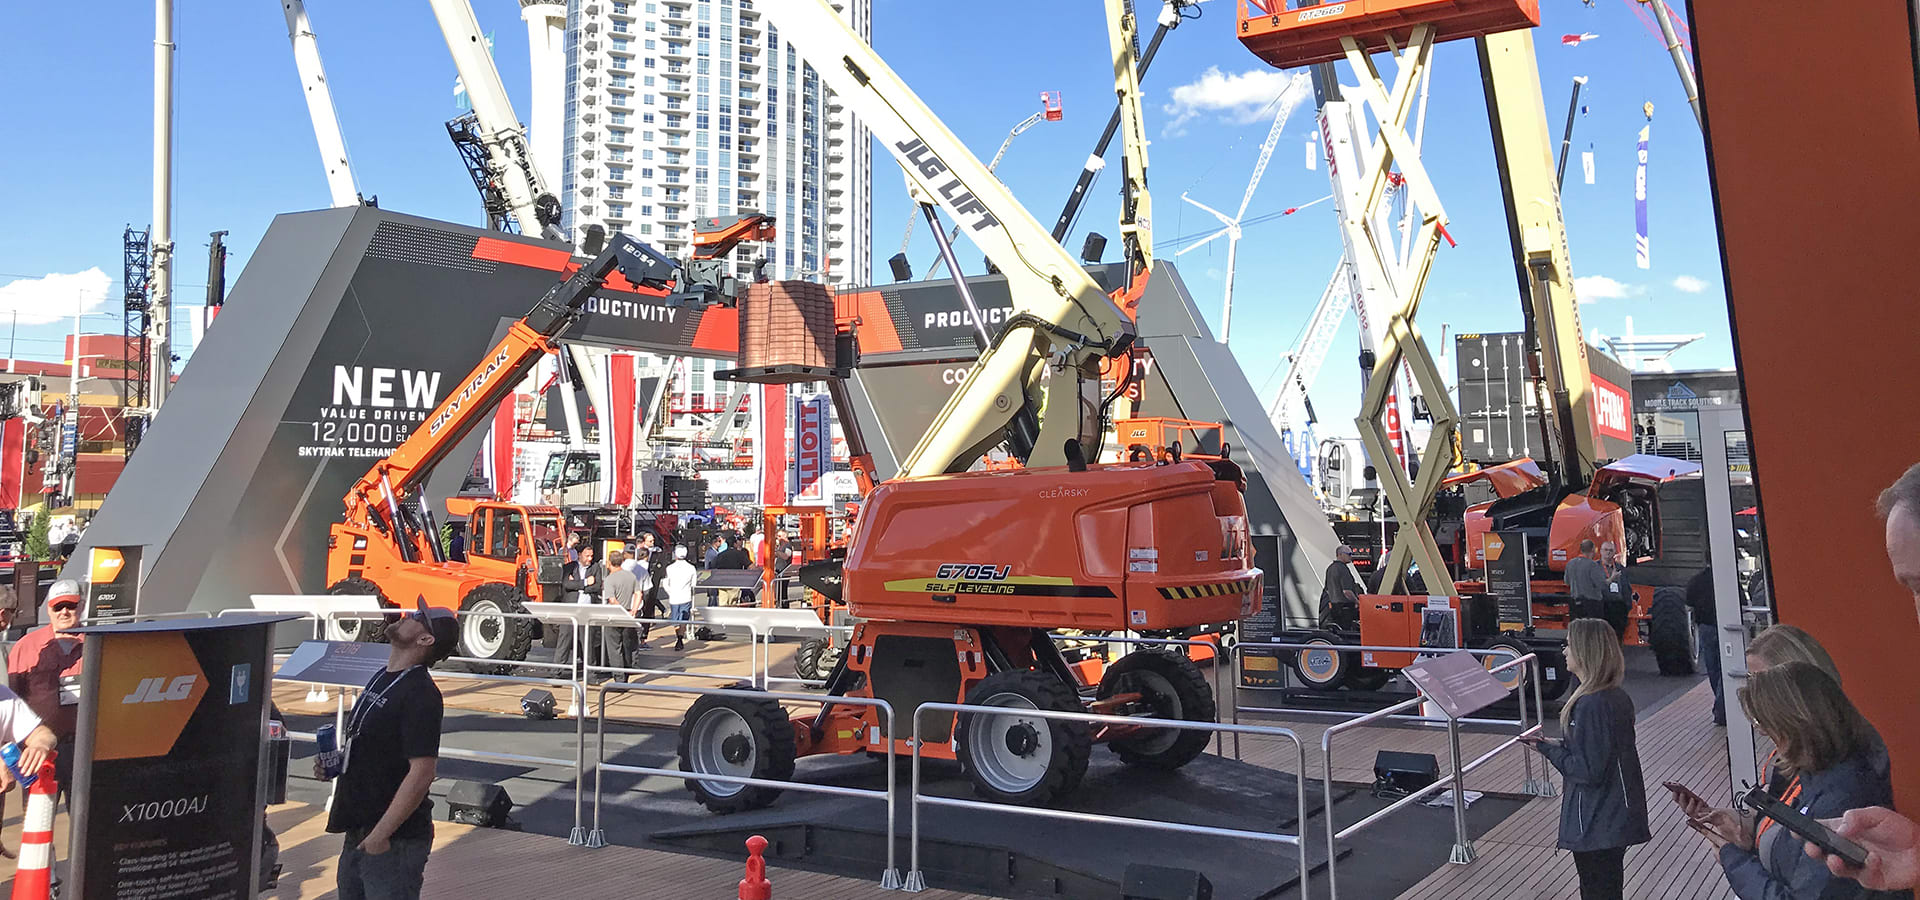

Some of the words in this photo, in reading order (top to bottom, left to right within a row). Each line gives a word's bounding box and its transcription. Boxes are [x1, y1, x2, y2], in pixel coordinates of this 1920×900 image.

[1298, 3, 1346, 22] RT2669
[1321, 114, 1338, 178] ELLIOTT
[895, 138, 947, 180] JLG
[937, 178, 999, 231] LIFT
[587, 296, 676, 323] DUCTIVITY
[925, 307, 1013, 328] PRODUCT
[333, 365, 441, 409] NEW
[430, 344, 509, 437] SKYTRAK
[1668, 398, 1687, 407] TRACK
[320, 407, 366, 420] VALUE
[374, 410, 426, 421] DRIVEN
[312, 421, 392, 445] 12,000
[396, 434, 411, 442] CLA
[1131, 430, 1147, 439] JLG
[348, 447, 398, 457] TELEHAND
[800, 404, 819, 497] ELLIOTT
[1039, 486, 1090, 499] CLEARSKY
[936, 563, 1011, 581] 670SJ
[925, 583, 956, 592] SELF
[958, 584, 1016, 594] LEVELING
[122, 674, 197, 704] JLG
[118, 795, 208, 823] X1000AJ
